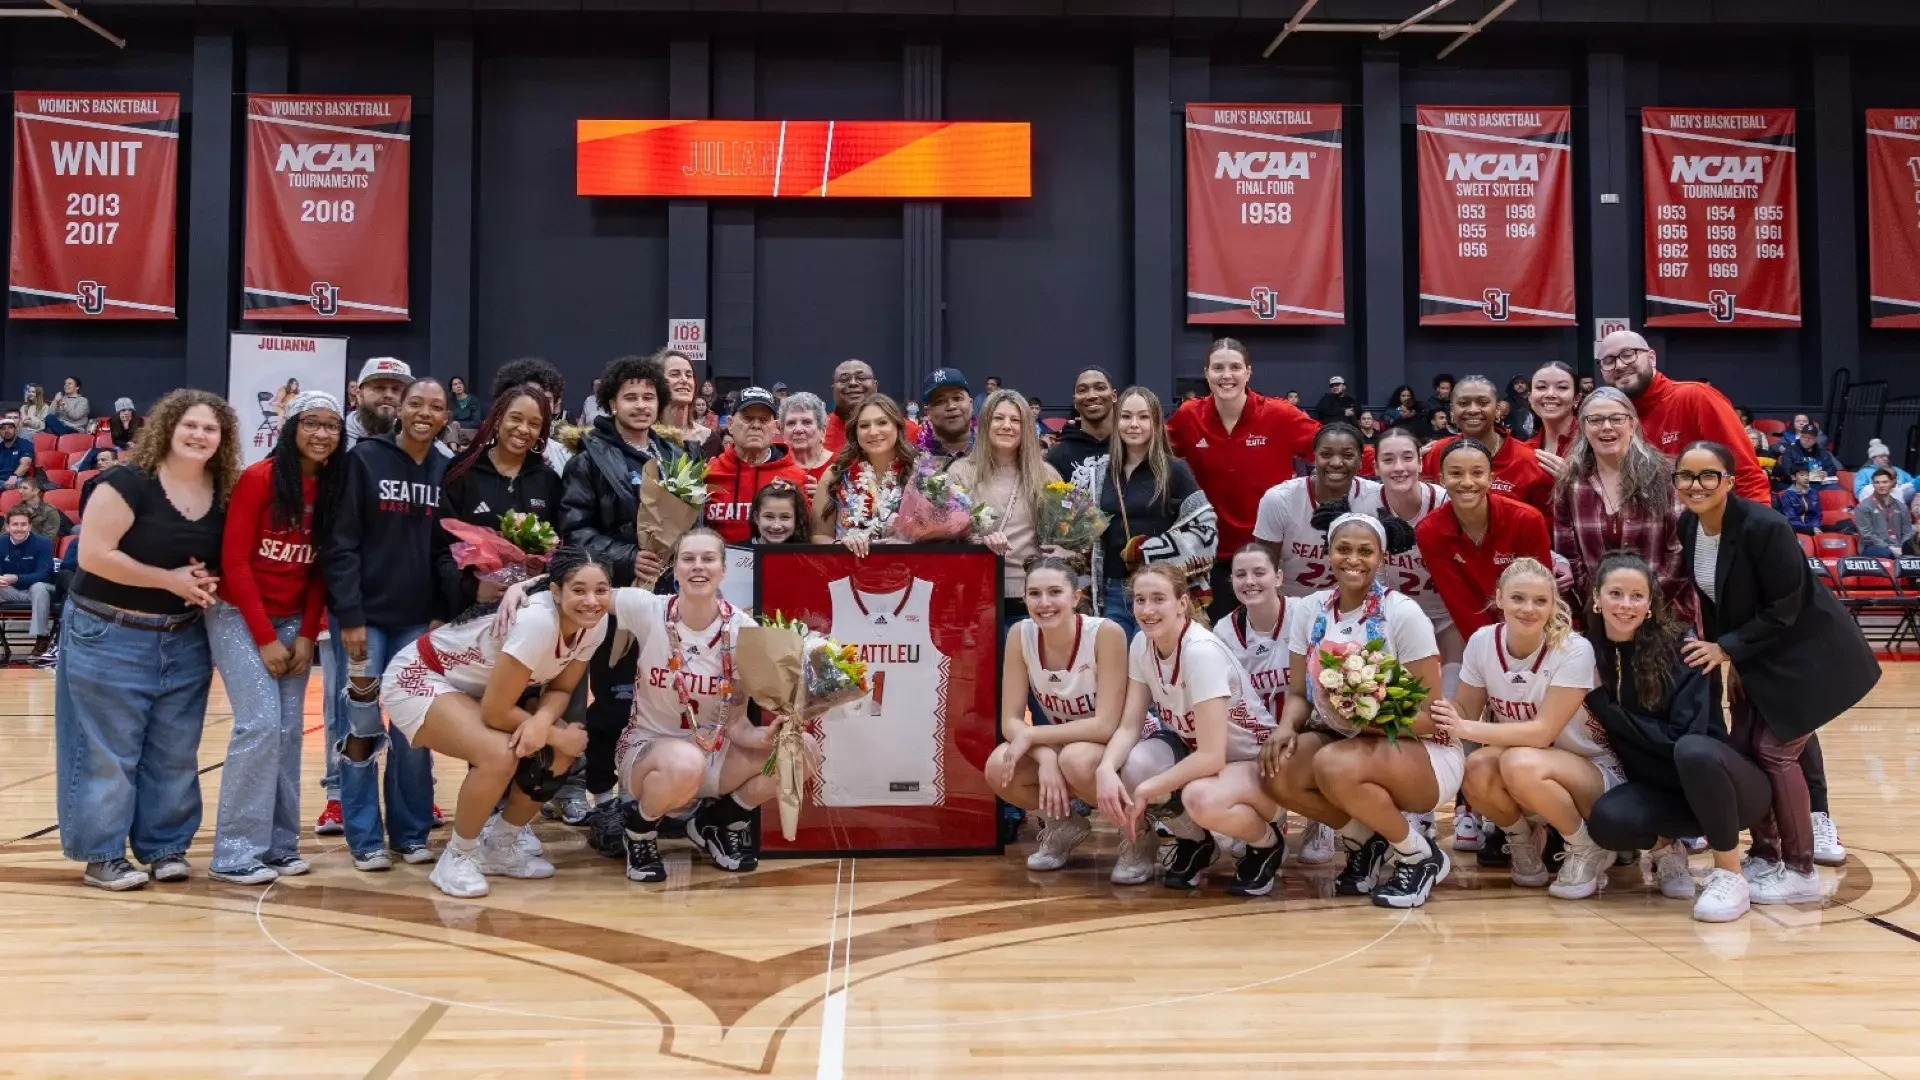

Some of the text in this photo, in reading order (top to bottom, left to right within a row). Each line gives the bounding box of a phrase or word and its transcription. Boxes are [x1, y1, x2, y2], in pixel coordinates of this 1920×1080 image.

[38, 99, 160, 114] WOMEN'S BASKETBALL
[271, 101, 391, 117] WOMEN'S BASKETBALL
[1214, 110, 1313, 125] MEN'S BASKETBALL
[1444, 112, 1542, 127] MEN'S BASKETBALL
[1670, 114, 1767, 129] MEN'S BASKETBALL
[1894, 115, 1920, 130] MEN'
[51, 141, 143, 176] WNIT
[682, 141, 796, 176] JULIAN
[288, 174, 368, 188] TOURNAMENTS
[1236, 181, 1294, 195] FINAL FOUR
[1456, 183, 1534, 197] SWEET SIXTEEN
[1683, 184, 1758, 198] TOURNAMENTS
[66, 193, 120, 216] 2013
[301, 200, 355, 223] 2018
[1457, 204, 1535, 219] 1953 1958
[1241, 202, 1292, 224] 1958
[1657, 205, 1783, 221] 1953 1954 1955
[65, 221, 119, 245] 2017
[1458, 224, 1536, 238] 1955 1964
[1657, 225, 1782, 240] 1956 1958 1961
[1458, 243, 1487, 257] 1956
[1658, 244, 1784, 259] 1962 1963 1964
[1658, 263, 1738, 278] 1967 1969
[674, 325, 700, 340] 108
[258, 337, 316, 353] JULIANNA
[378, 479, 441, 508] SEATTLE
[707, 502, 752, 520] SEATT
[259, 538, 317, 564] SEATTL
[1292, 542, 1328, 560] SEAT
[1845, 560, 1879, 570] SEATTLE
[1900, 560, 1920, 570] SEAT
[841, 644, 920, 663] ATTLEU
[650, 668, 722, 695] SETTLE
[1250, 667, 1290, 690] ATTLE
[870, 671, 885, 716] 1
[1490, 697, 1537, 721] SEATT
